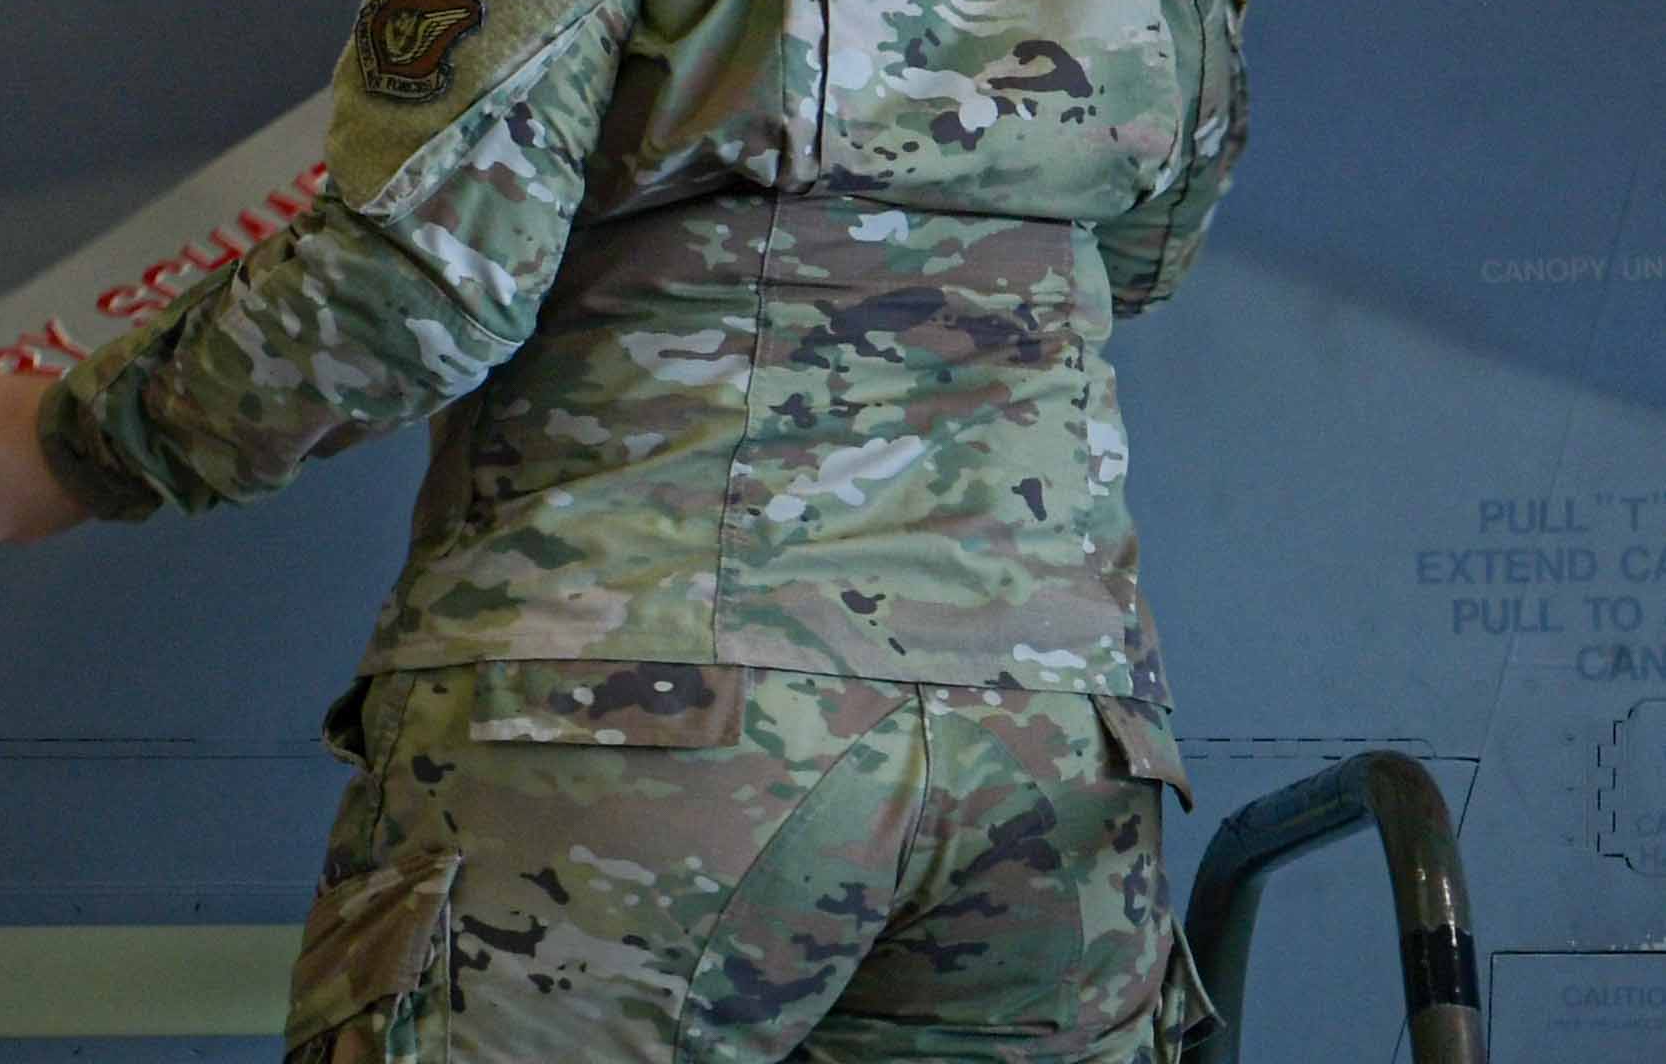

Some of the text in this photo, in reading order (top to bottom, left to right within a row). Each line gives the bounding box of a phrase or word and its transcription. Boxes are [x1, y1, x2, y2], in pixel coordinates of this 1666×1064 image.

[1480, 257, 1608, 284] CANOPY
[1477, 497, 1589, 535] PULL
[1416, 546, 1598, 585] EXTEND
[1452, 593, 1644, 635] PULL TO
